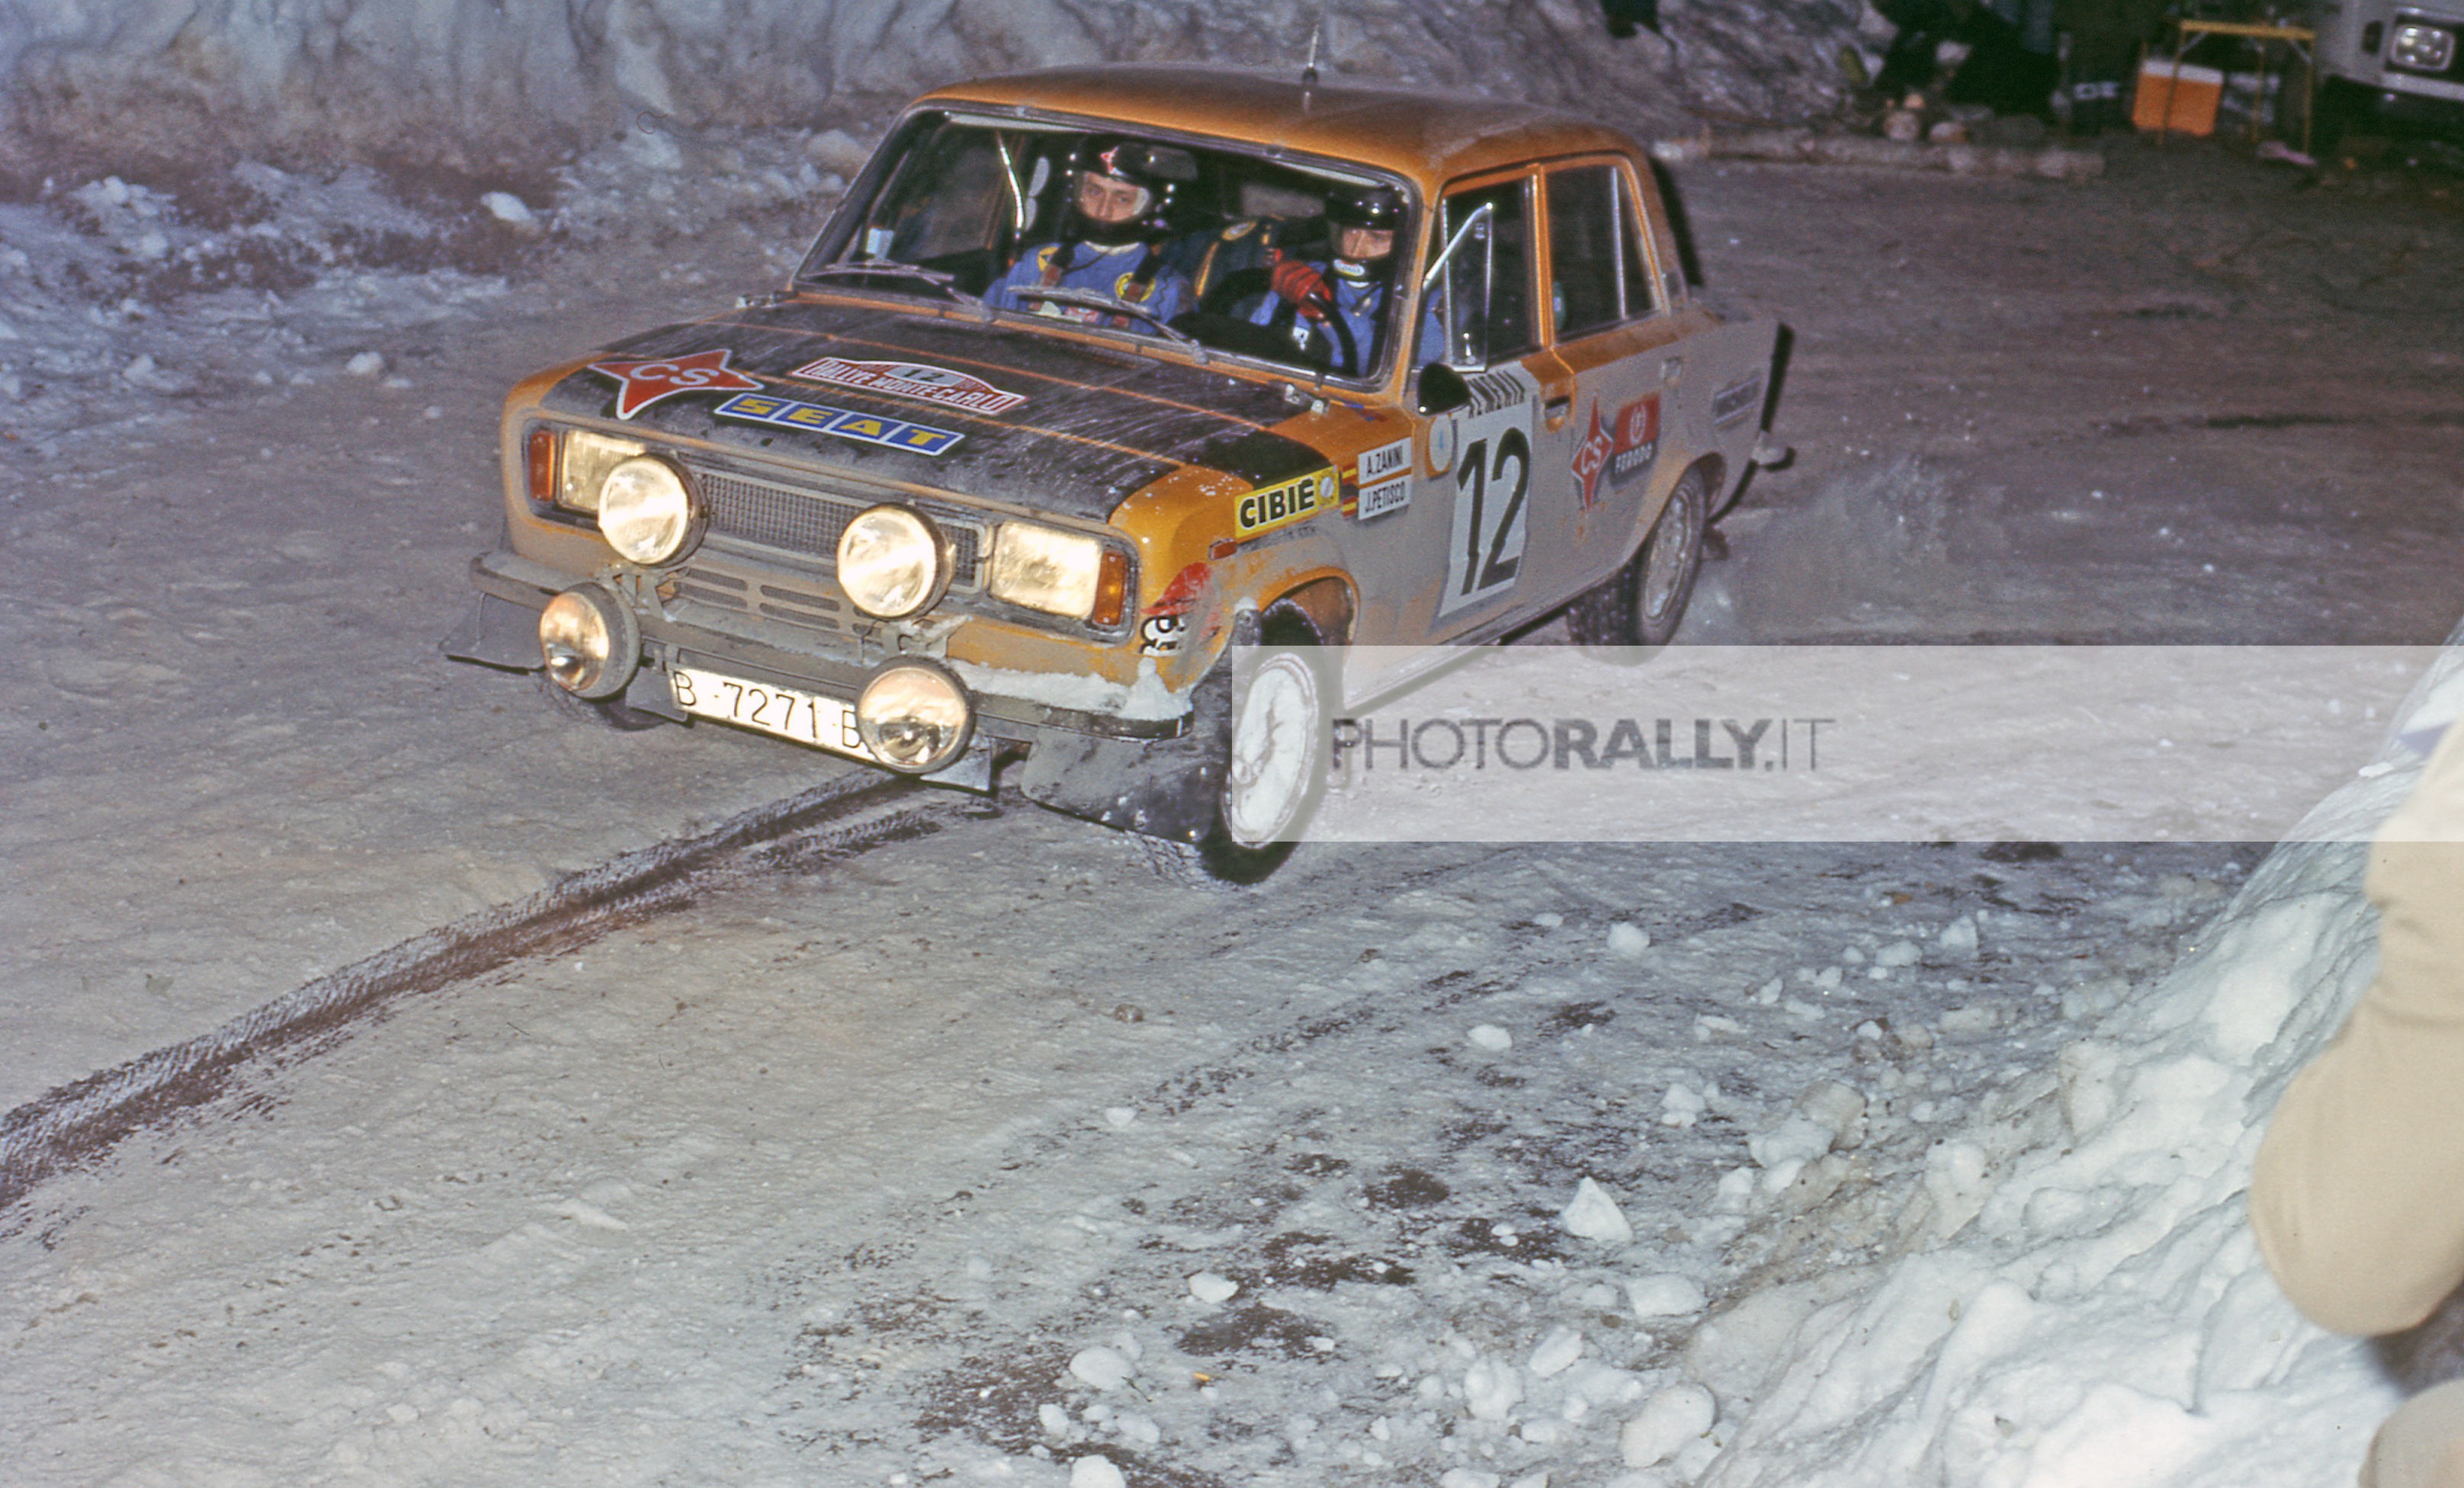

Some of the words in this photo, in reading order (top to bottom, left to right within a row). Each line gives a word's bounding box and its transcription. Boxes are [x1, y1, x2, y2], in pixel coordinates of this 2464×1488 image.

[630, 363, 720, 386] CS
[804, 359, 877, 383] RALLYE
[868, 376, 1015, 411] MONTE-CARLO
[903, 369, 945, 382] 12
[731, 398, 947, 446] SEAT
[1457, 427, 1531, 596] 12
